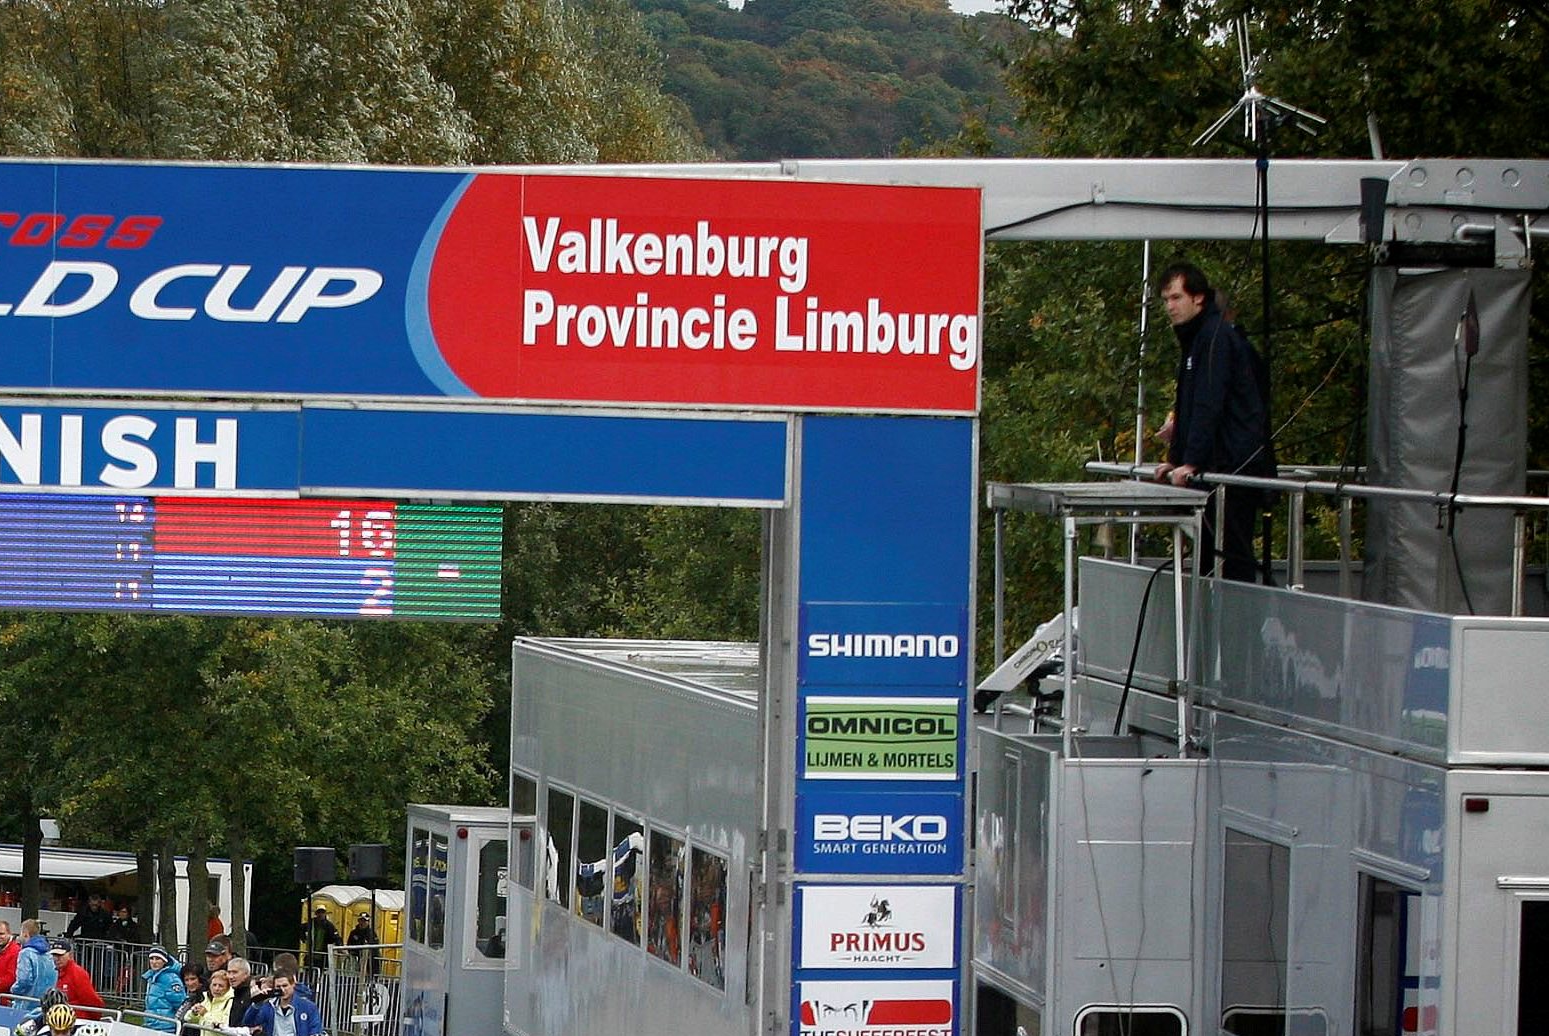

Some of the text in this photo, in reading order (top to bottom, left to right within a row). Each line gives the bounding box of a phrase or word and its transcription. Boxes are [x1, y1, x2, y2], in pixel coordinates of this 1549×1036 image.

[522, 216, 809, 294] Valkenburg
[128, 263, 384, 323] CUP
[522, 289, 979, 372] Provincie Limburg
[808, 633, 959, 658] SHIMANO
[807, 716, 955, 736] OMNICOL
[806, 752, 955, 768] LIJMEN & MORTELS
[813, 814, 948, 842] BEKO
[813, 842, 948, 856] SMART GENERATION
[830, 932, 925, 953] PRIMUS
[853, 955, 901, 963] HAACHT
